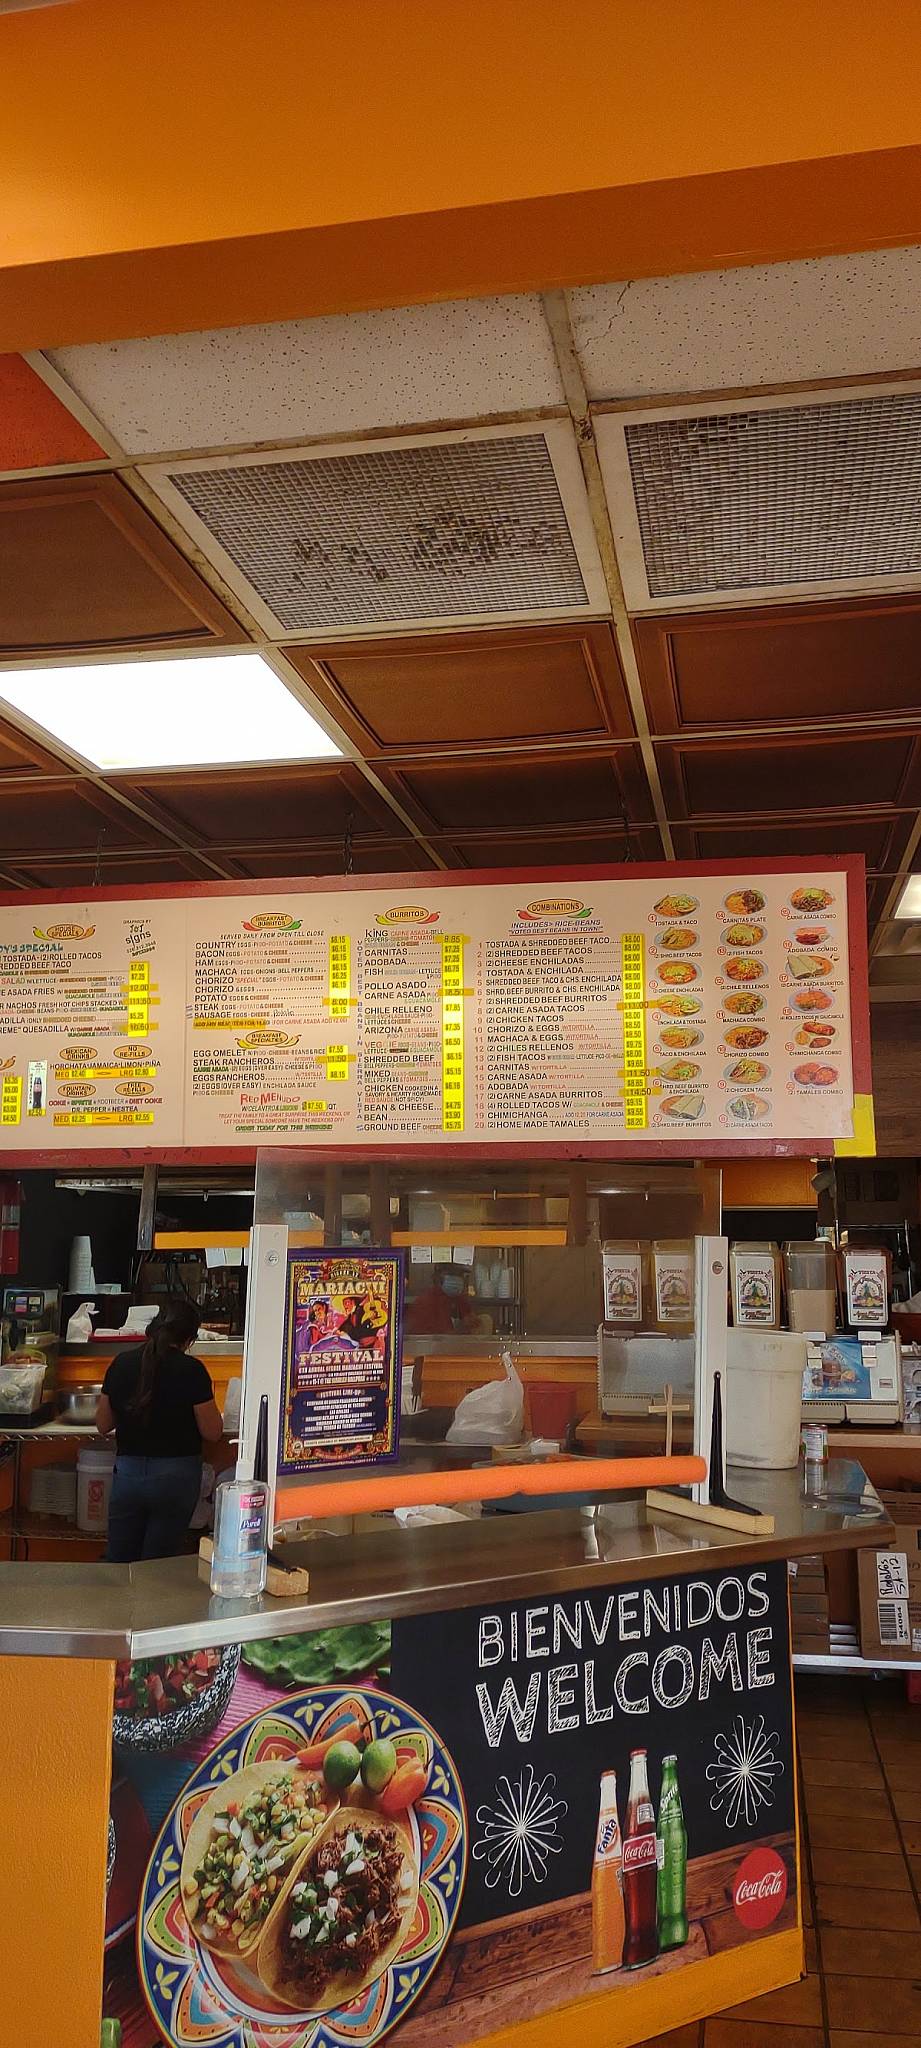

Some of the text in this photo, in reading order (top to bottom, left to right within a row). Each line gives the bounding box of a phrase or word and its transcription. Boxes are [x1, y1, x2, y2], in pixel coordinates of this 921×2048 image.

[531, 903, 580, 912] COMBINATIONS
[195, 941, 236, 949] COUNTRY
[195, 950, 225, 958] BACON
[364, 948, 408, 956] CARNITAS
[495, 949, 539, 957] SHREDDED
[564, 947, 593, 955] TACOS
[364, 958, 406, 966] ADOBADA
[495, 959, 527, 967] CHEESE
[530, 957, 584, 965] ENCHILADAS
[195, 968, 237, 976] MACHACA
[535, 967, 584, 975] ENCHILADA
[195, 977, 234, 985] CHORIZO
[364, 981, 427, 990] POLLO ASADO
[364, 992, 394, 1000] CARNE
[496, 997, 540, 1005] SHREDDED
[565, 994, 607, 1002] BURRITOS
[393, 1005, 432, 1013] RELLENO
[496, 1016, 533, 1024] CHICKEN
[365, 1026, 403, 1034] ARIZONA
[536, 1024, 560, 1032] EGGS
[497, 1044, 526, 1052] CHILES
[529, 1043, 574, 1051] RELLENOS
[213, 1049, 246, 1057] OMELET
[193, 1057, 275, 1067] STEAK RANCHEROS
[364, 1055, 410, 1063] SHREDDED
[487, 1063, 530, 1071] CARNITAS
[193, 1073, 265, 1082] EGGS RANCHEROS
[487, 1072, 547, 1081] CARNE ASADA
[364, 1084, 403, 1092] CHICKEN
[487, 1082, 529, 1090] ADOBADA
[497, 1092, 525, 1100] CARNE
[528, 1091, 557, 1099] ASADA
[559, 1090, 603, 1098] BURRITOS
[497, 1101, 530, 1109] ROLLED
[487, 1111, 548, 1119] CHIMICHANGA
[524, 1120, 548, 1128] MADE
[550, 1119, 589, 1127] TAMALES
[299, 1350, 384, 1366] FESTIVAL
[479, 1573, 770, 1667] BIENVENIDOS
[476, 1627, 775, 1747] WELCOME
[598, 1819, 616, 1854] Fanta
